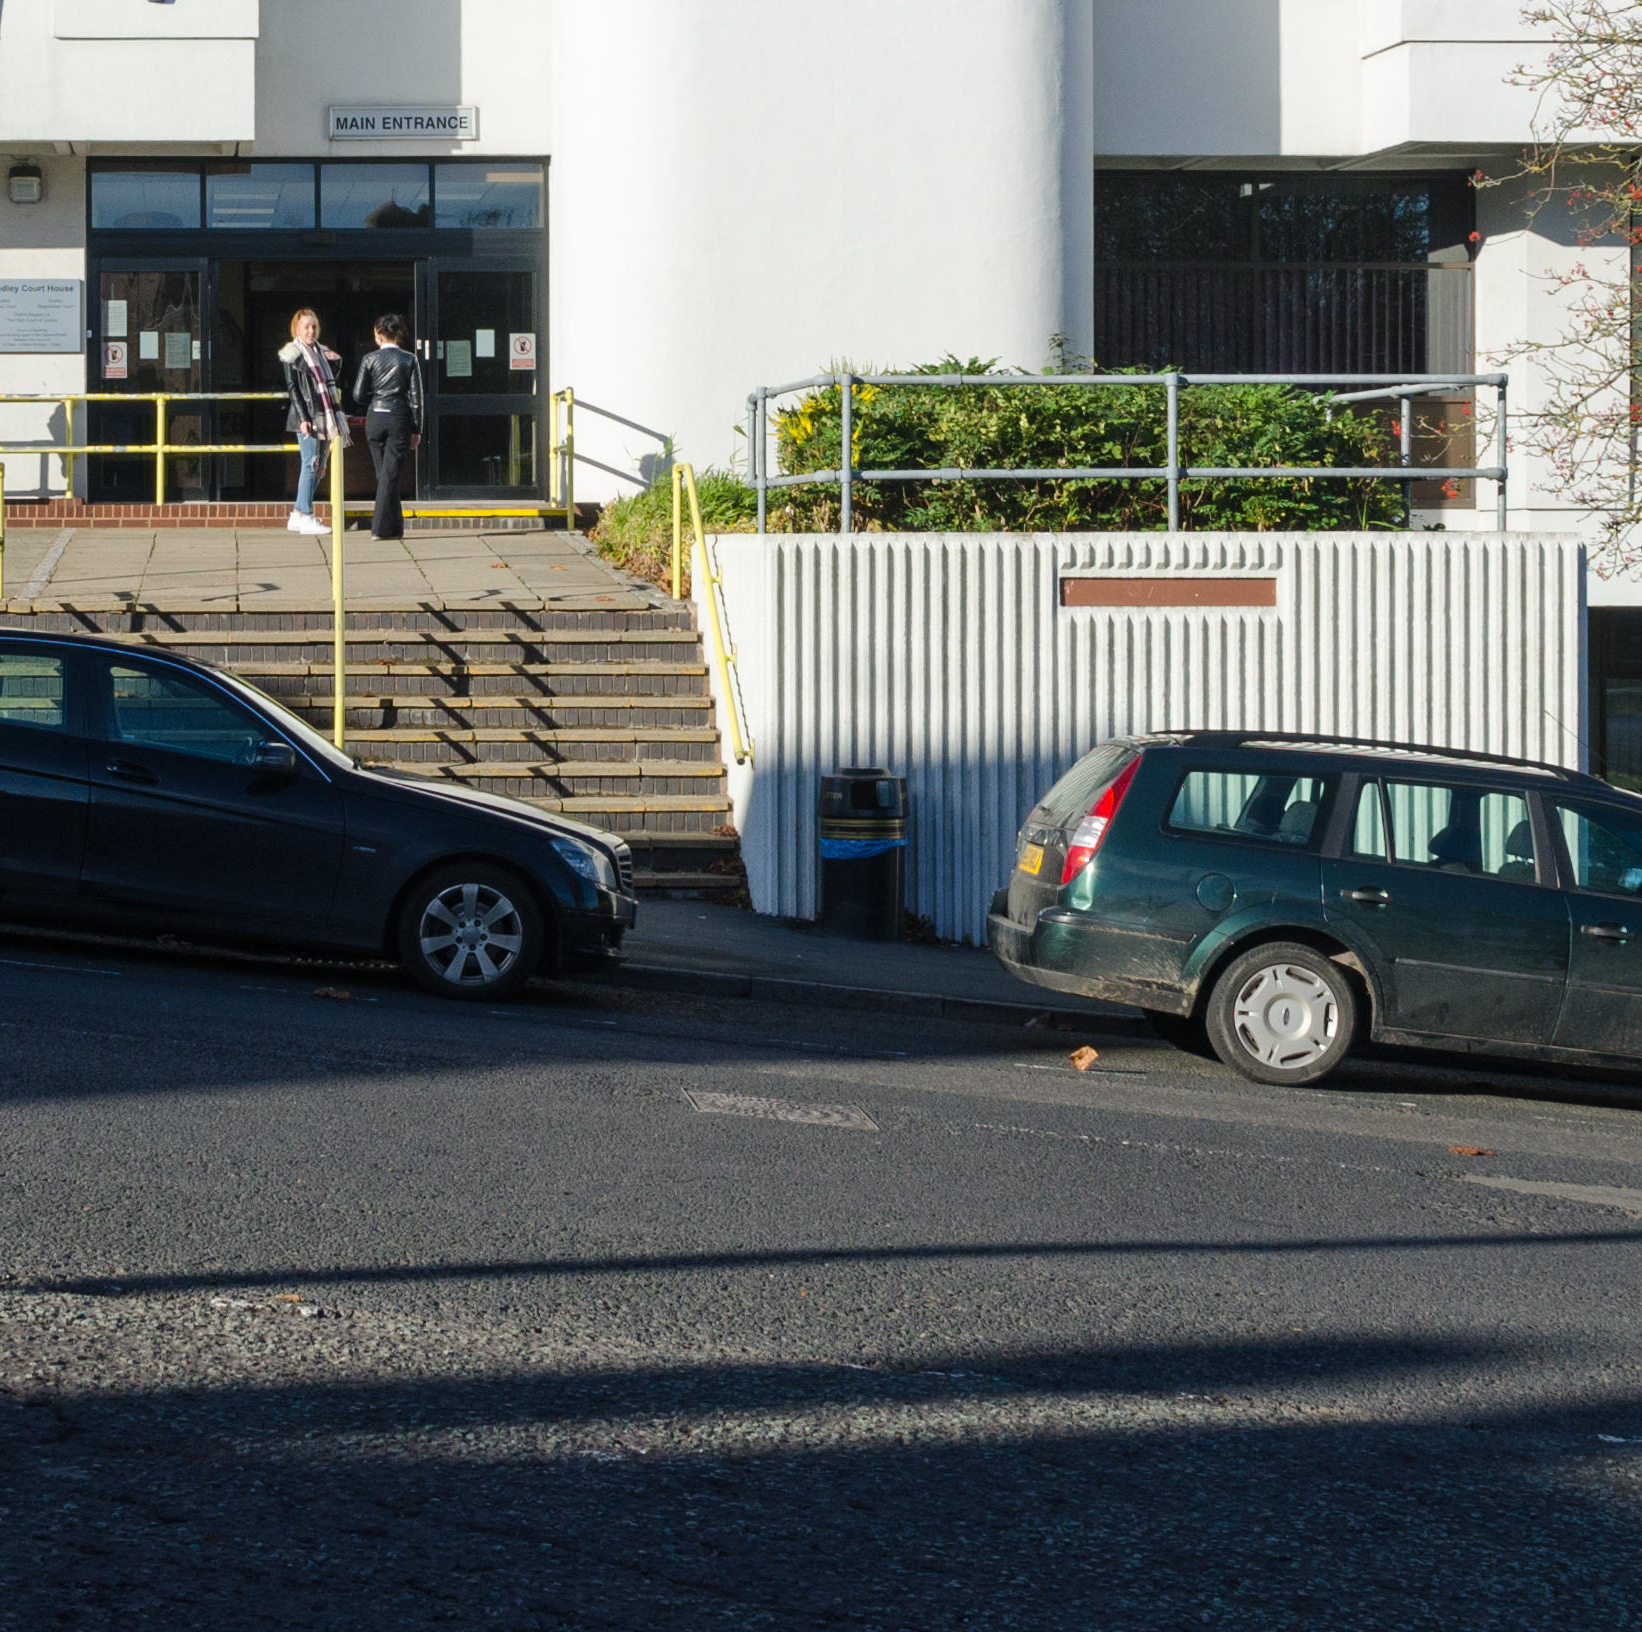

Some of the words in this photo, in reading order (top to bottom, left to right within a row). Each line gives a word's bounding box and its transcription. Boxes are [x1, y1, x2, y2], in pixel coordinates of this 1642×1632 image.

[336, 116, 375, 130] MAIN
[382, 116, 468, 130] ENTRANCE
[21, 284, 45, 293] Court
[47, 284, 74, 293] House
